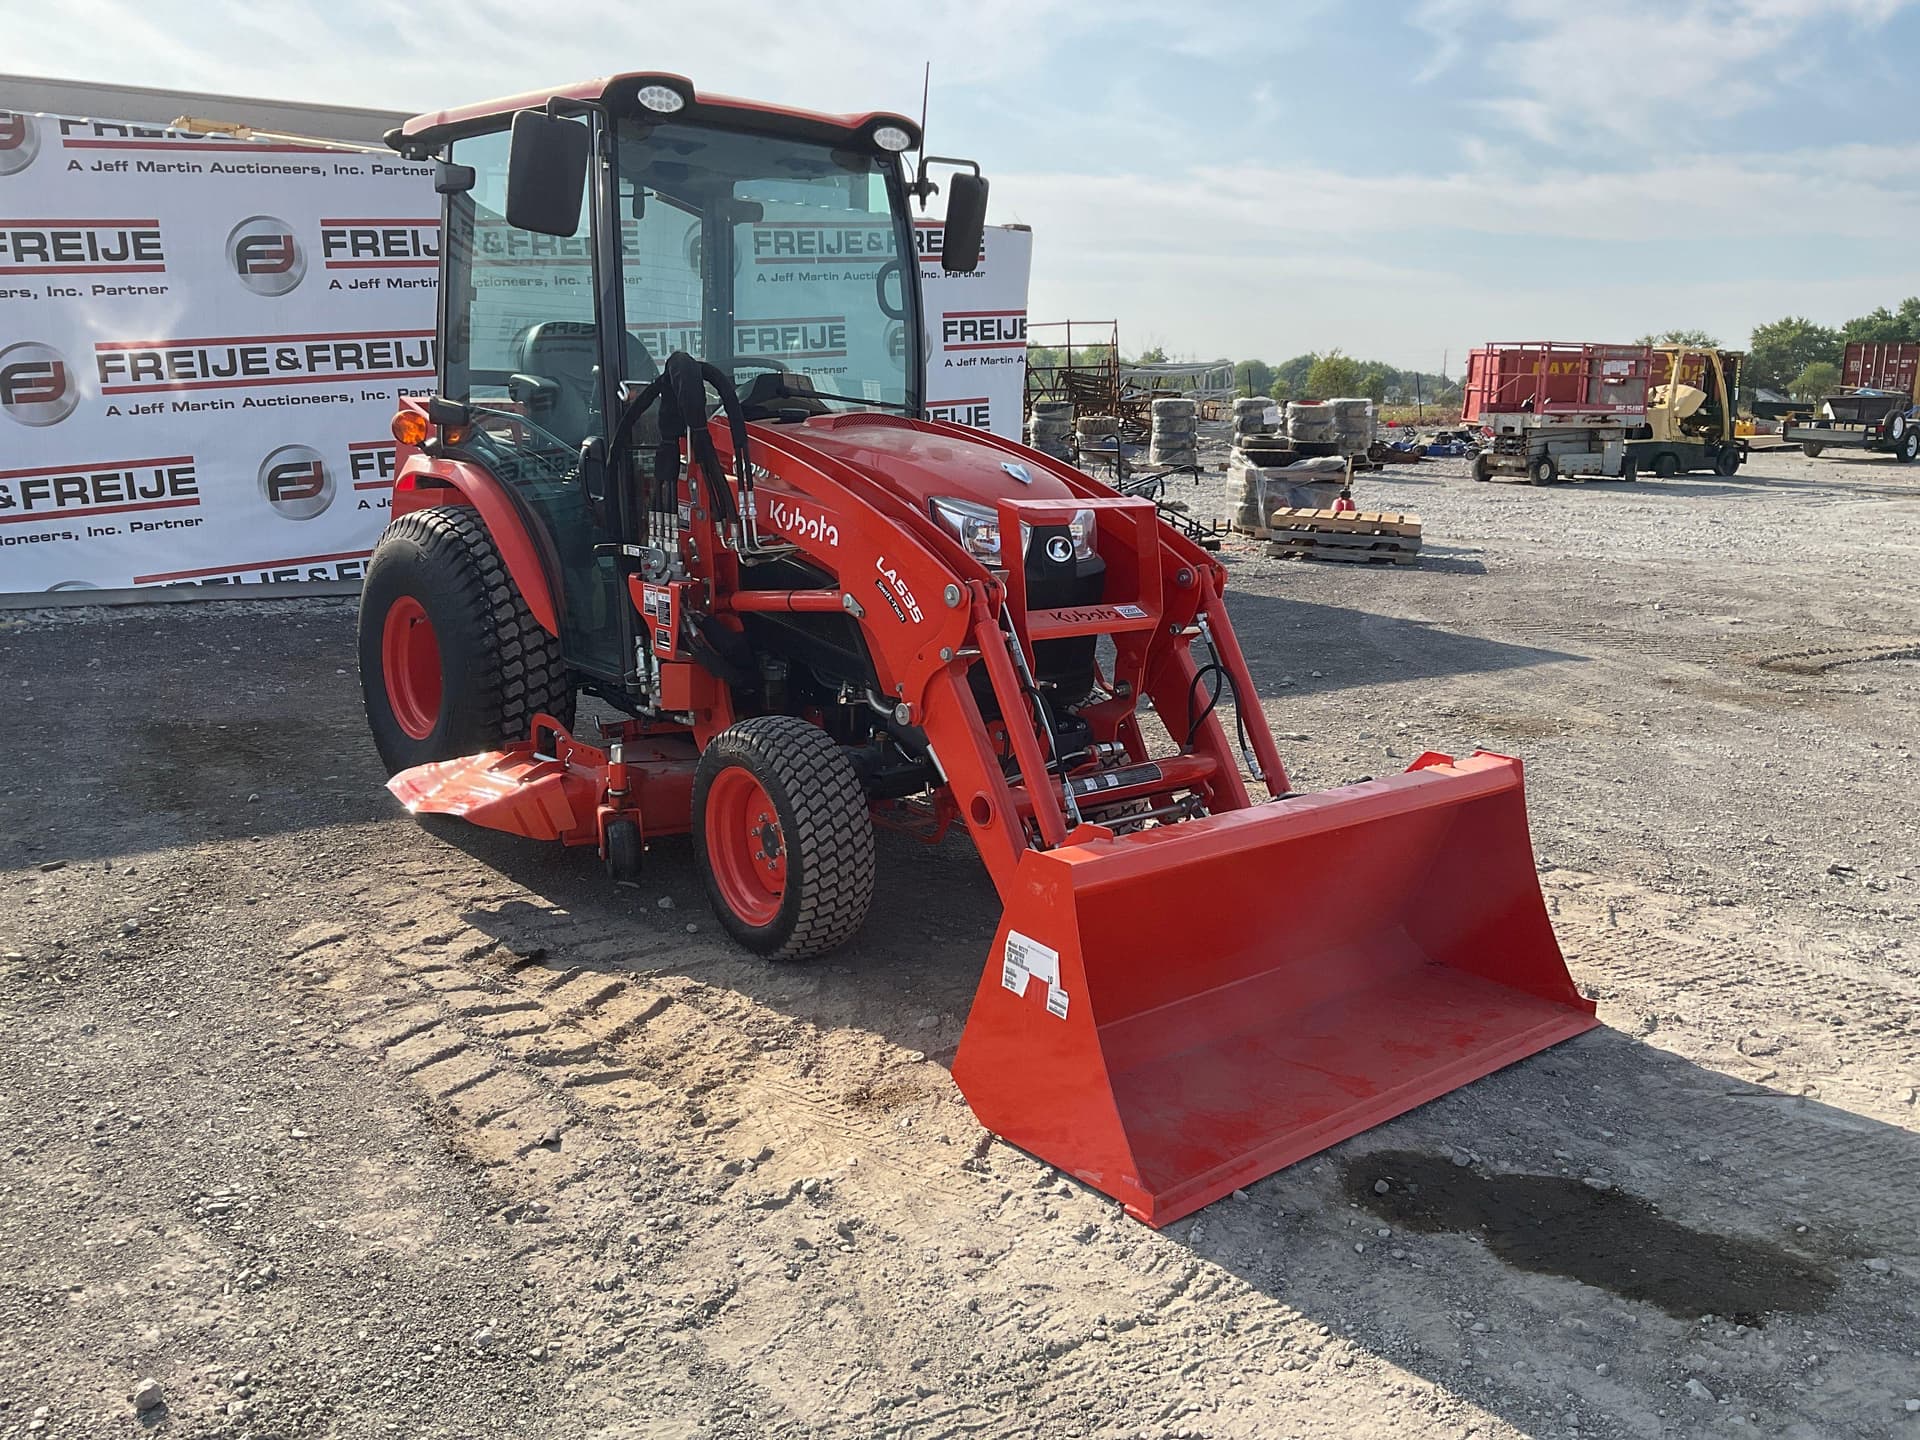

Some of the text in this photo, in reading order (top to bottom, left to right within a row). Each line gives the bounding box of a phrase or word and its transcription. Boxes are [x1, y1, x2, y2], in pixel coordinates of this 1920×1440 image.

[67, 159, 435, 177] A Jeff Martin Auctioneers, Inc. Partner
[0, 231, 165, 263] REIJE
[329, 278, 343, 290] A
[348, 277, 381, 290] Jeff
[771, 271, 793, 282] Jeff
[799, 270, 839, 281] Martin
[47, 285, 83, 297] Inc.
[91, 284, 169, 297] Partner
[957, 357, 977, 367] Jeff
[980, 355, 1014, 365] Martin
[106, 405, 121, 417] A
[128, 402, 165, 416] Jeff
[172, 398, 235, 413] Martin
[242, 392, 354, 409] Auctioneers,
[361, 389, 391, 401] Inc.
[87, 526, 122, 538] Inc.
[130, 516, 204, 533] Partner
[769, 499, 839, 547] Kubota
[876, 556, 925, 624] LA535
[1049, 608, 1120, 623] Kubota
